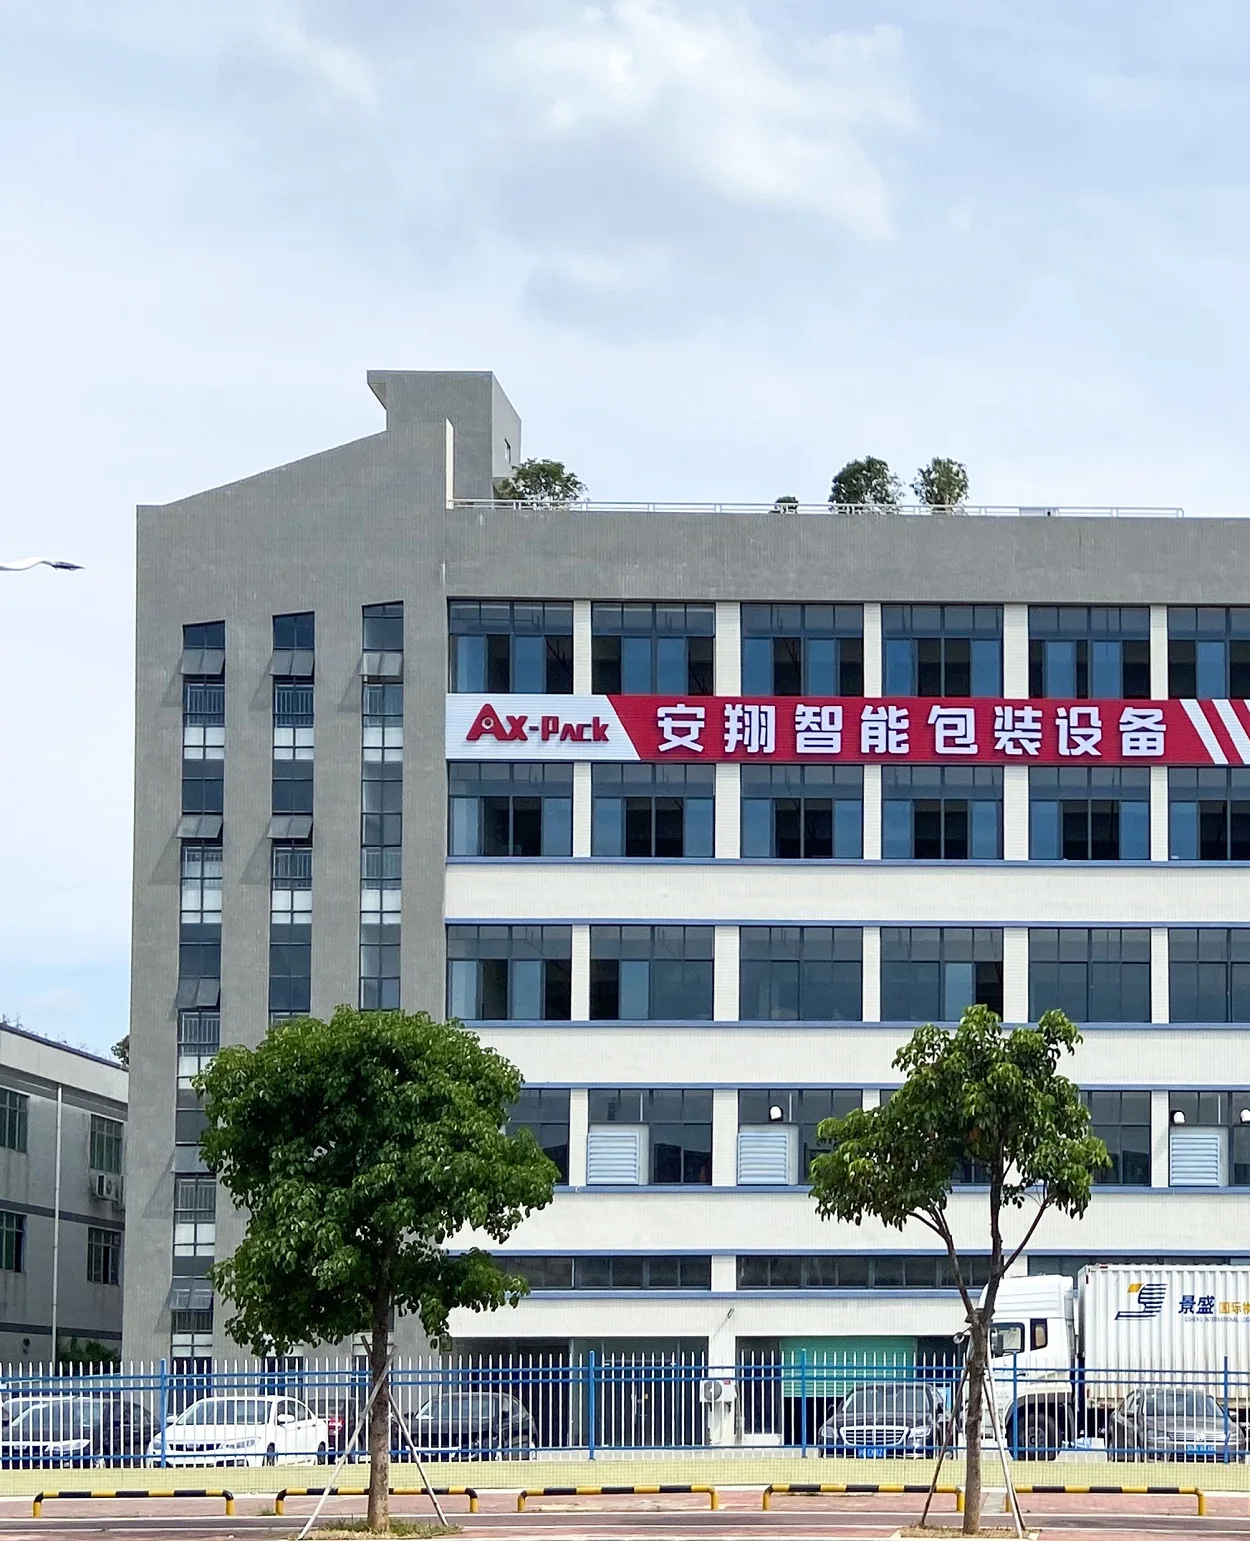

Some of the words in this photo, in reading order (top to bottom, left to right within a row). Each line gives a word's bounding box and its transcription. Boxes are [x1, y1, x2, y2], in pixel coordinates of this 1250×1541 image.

[656, 703, 1168, 757] 安翔智能包装设备
[1178, 1295, 1215, 1315] 景盛
